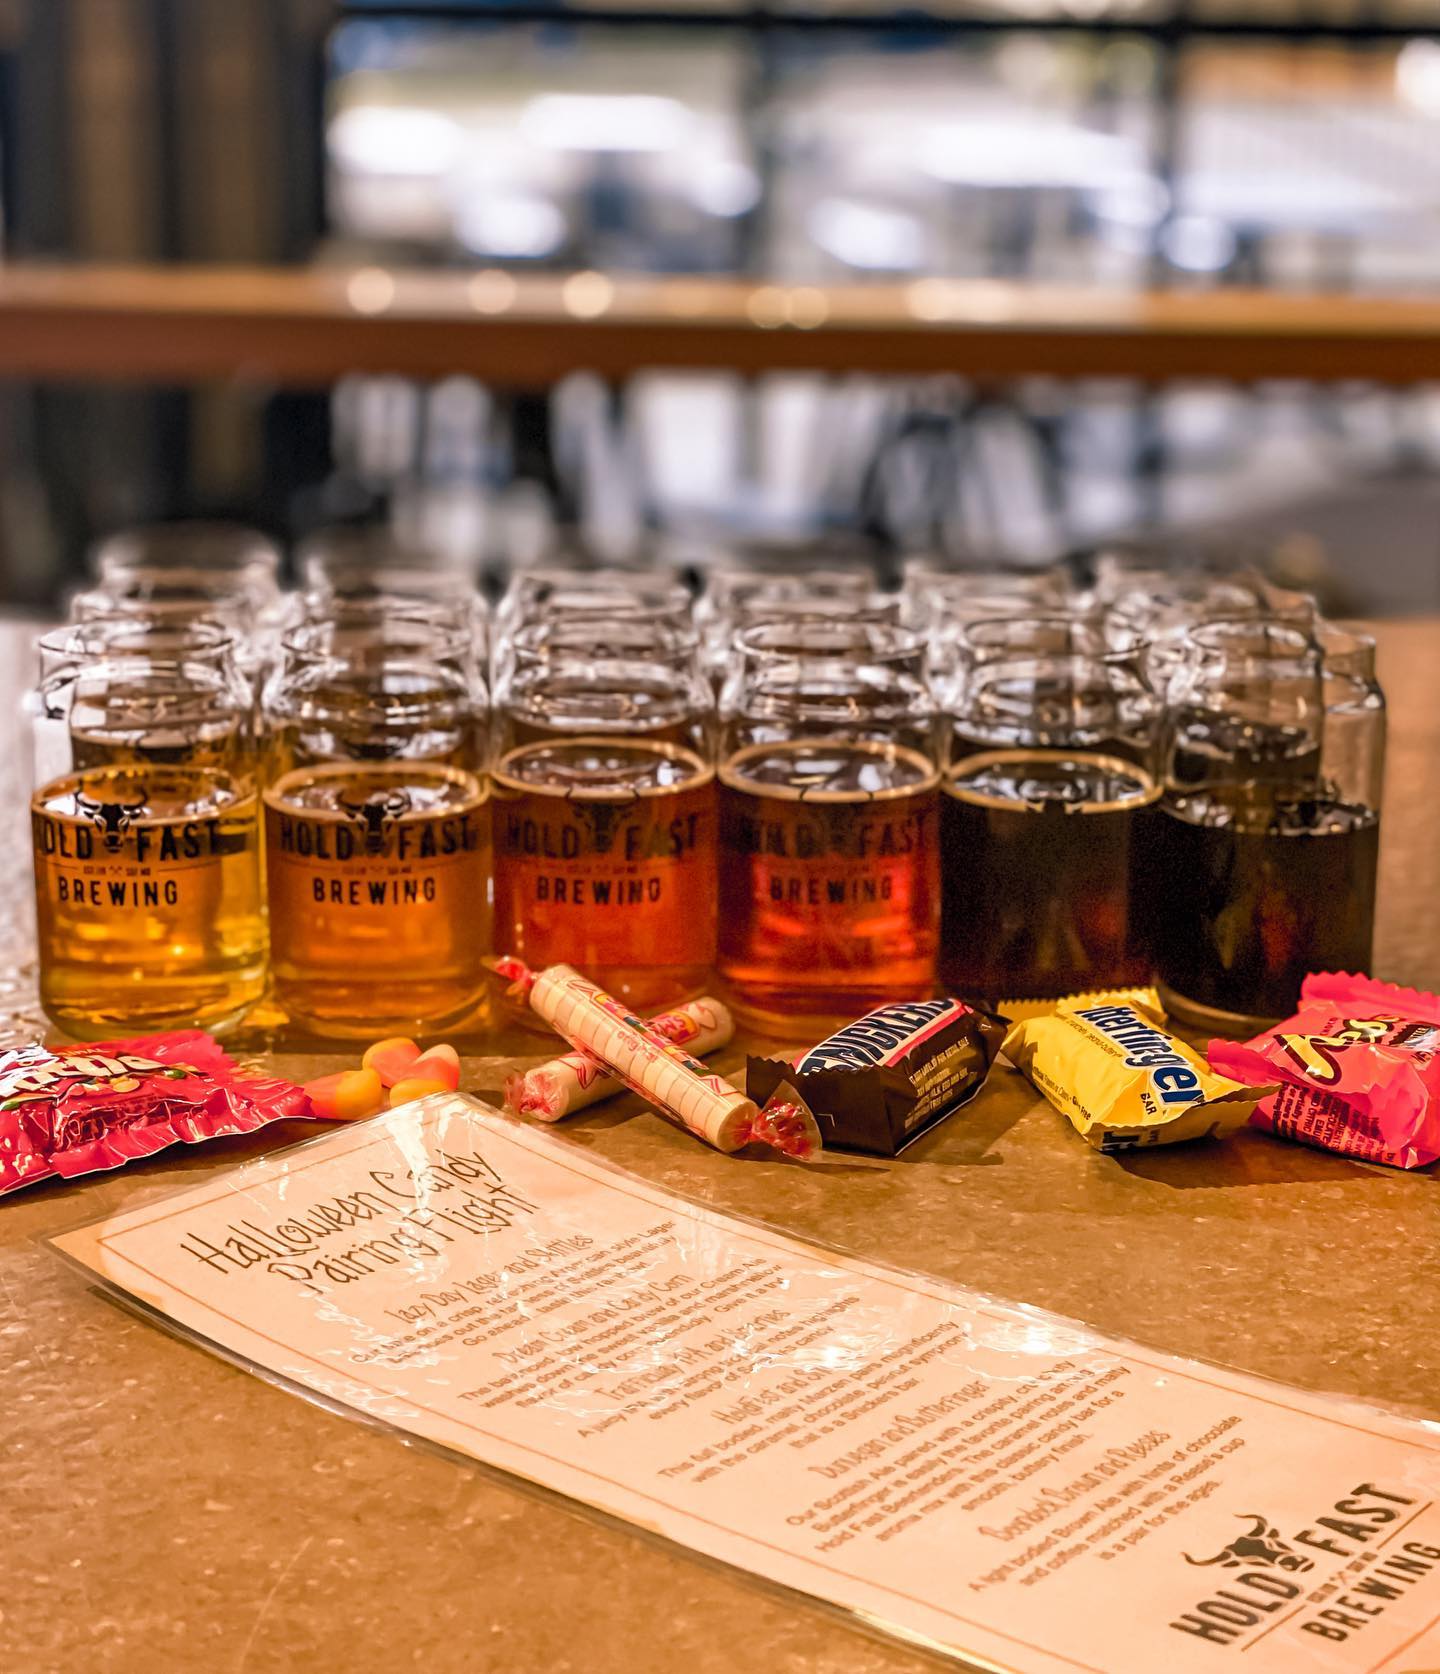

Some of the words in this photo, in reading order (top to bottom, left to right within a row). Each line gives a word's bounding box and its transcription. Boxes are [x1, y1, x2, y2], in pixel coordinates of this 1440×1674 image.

[136, 819, 221, 861] FAST
[280, 816, 354, 860] HOLD
[397, 816, 470, 860] FAST
[505, 814, 580, 858] HOLD
[57, 878, 179, 906] BREWING
[312, 876, 437, 905] BREWING
[536, 876, 661, 906] BREWING
[769, 876, 893, 905] BREWING
[1139, 1092, 1158, 1116] BAR
[181, 1193, 400, 1275] Halloween
[370, 1150, 502, 1199] Candy
[268, 1229, 440, 1296] Pairing
[403, 1183, 540, 1242] Flight
[415, 1327, 438, 1338] on
[610, 1237, 642, 1252] style
[637, 1220, 678, 1239] Lager
[419, 1289, 471, 1308] Day
[502, 1256, 543, 1276] and
[525, 1234, 597, 1264] Skittles
[453, 1323, 480, 1336] out
[475, 1314, 503, 1326] the
[457, 1387, 493, 1402] The
[555, 1344, 585, 1357] low
[580, 1321, 635, 1345] hopped
[630, 1306, 667, 1323] brew
[665, 1297, 682, 1307] of
[679, 1288, 703, 1300] our
[700, 1269, 746, 1289] Cream
[742, 1259, 768, 1269] Ale
[461, 1335, 489, 1347] Go
[492, 1340, 551, 1364] Dream
[538, 1320, 596, 1343] Cream
[585, 1308, 621, 1324] and
[606, 1290, 663, 1313] Candy
[648, 1274, 697, 1293] Corn
[535, 1364, 576, 1384] down
[678, 1302, 707, 1316] and
[703, 1263, 785, 1304] marshmallow
[558, 1380, 577, 1390] of
[714, 1298, 749, 1314] Give
[702, 1334, 737, 1353] and
[576, 1429, 597, 1439] A
[682, 1366, 726, 1388] strong
[766, 1325, 806, 1344] notes
[799, 1296, 862, 1326] highlights
[774, 1376, 811, 1395] and
[647, 1400, 691, 1421] every
[684, 1381, 725, 1402] flavor
[724, 1372, 743, 1383] of
[657, 1461, 695, 1479] This
[848, 1363, 885, 1382] pairs
[879, 1321, 961, 1364] magnificently
[719, 1453, 749, 1468] the
[867, 1365, 914, 1390] peanut
[894, 1380, 993, 1430] Butterfinger
[788, 1433, 822, 1451] that
[818, 1426, 835, 1435] is
[831, 1420, 847, 1428] a
[840, 1391, 901, 1421] Snickers
[879, 1422, 917, 1443] and
[809, 1487, 894, 1534] Butterfinger
[890, 1479, 910, 1489] is
[904, 1457, 949, 1481] easily
[941, 1445, 969, 1459] the
[962, 1418, 1014, 1445] favorite
[1009, 1393, 1057, 1420] pairing
[816, 1531, 856, 1553] Hold
[850, 1513, 887, 1533] Fast
[961, 1450, 995, 1465] The
[990, 1420, 1043, 1451] caramel
[1038, 1401, 1077, 1422] notes
[1071, 1385, 1100, 1402] and
[1094, 1366, 1133, 1388] malty
[874, 1515, 924, 1543] aroma
[919, 1499, 948, 1515] mix
[945, 1483, 975, 1500] with
[969, 1468, 999, 1484] this
[995, 1443, 1041, 1470] classic
[1037, 1420, 1078, 1444] candy
[1071, 1407, 1098, 1422] bar
[1091, 1396, 1116, 1409] for
[1111, 1390, 1126, 1399] a
[1009, 1453, 1060, 1483] buttery
[1091, 1455, 1132, 1477] and
[1220, 1438, 1249, 1454] cup
[785, 1509, 818, 1527] Our
[813, 1479, 874, 1511] Scottish
[868, 1466, 897, 1481] Ale
[892, 1441, 938, 1468] paired
[933, 1427, 965, 1443] with
[959, 1420, 976, 1428] a
[1163, 1484, 1180, 1493] a
[1170, 1453, 1227, 1486] Reese's
[967, 1582, 989, 1594] A
[978, 1564, 1016, 1585] light
[1007, 1536, 1060, 1568] bodied
[1051, 1511, 1100, 1539] Brown
[1093, 1496, 1123, 1512] Ale
[1116, 1480, 1148, 1498] with
[1139, 1461, 1178, 1481] hints
[1171, 1450, 1190, 1462] of
[1184, 1416, 1245, 1453] chocolate
[1138, 1491, 1169, 1508] with
[1085, 1507, 1144, 1544] matched
[1094, 1551, 1117, 1562] is
[1111, 1543, 1128, 1553] a
[1121, 1527, 1152, 1547] pair
[1143, 1514, 1170, 1528] for
[1162, 1501, 1193, 1516] the
[1018, 1567, 1052, 1587] and
[1046, 1544, 1091, 1571] coffee
[1170, 1574, 1304, 1646] HOLD
[1294, 1484, 1418, 1558] FAST
[1301, 1543, 1440, 1643] BREWING
